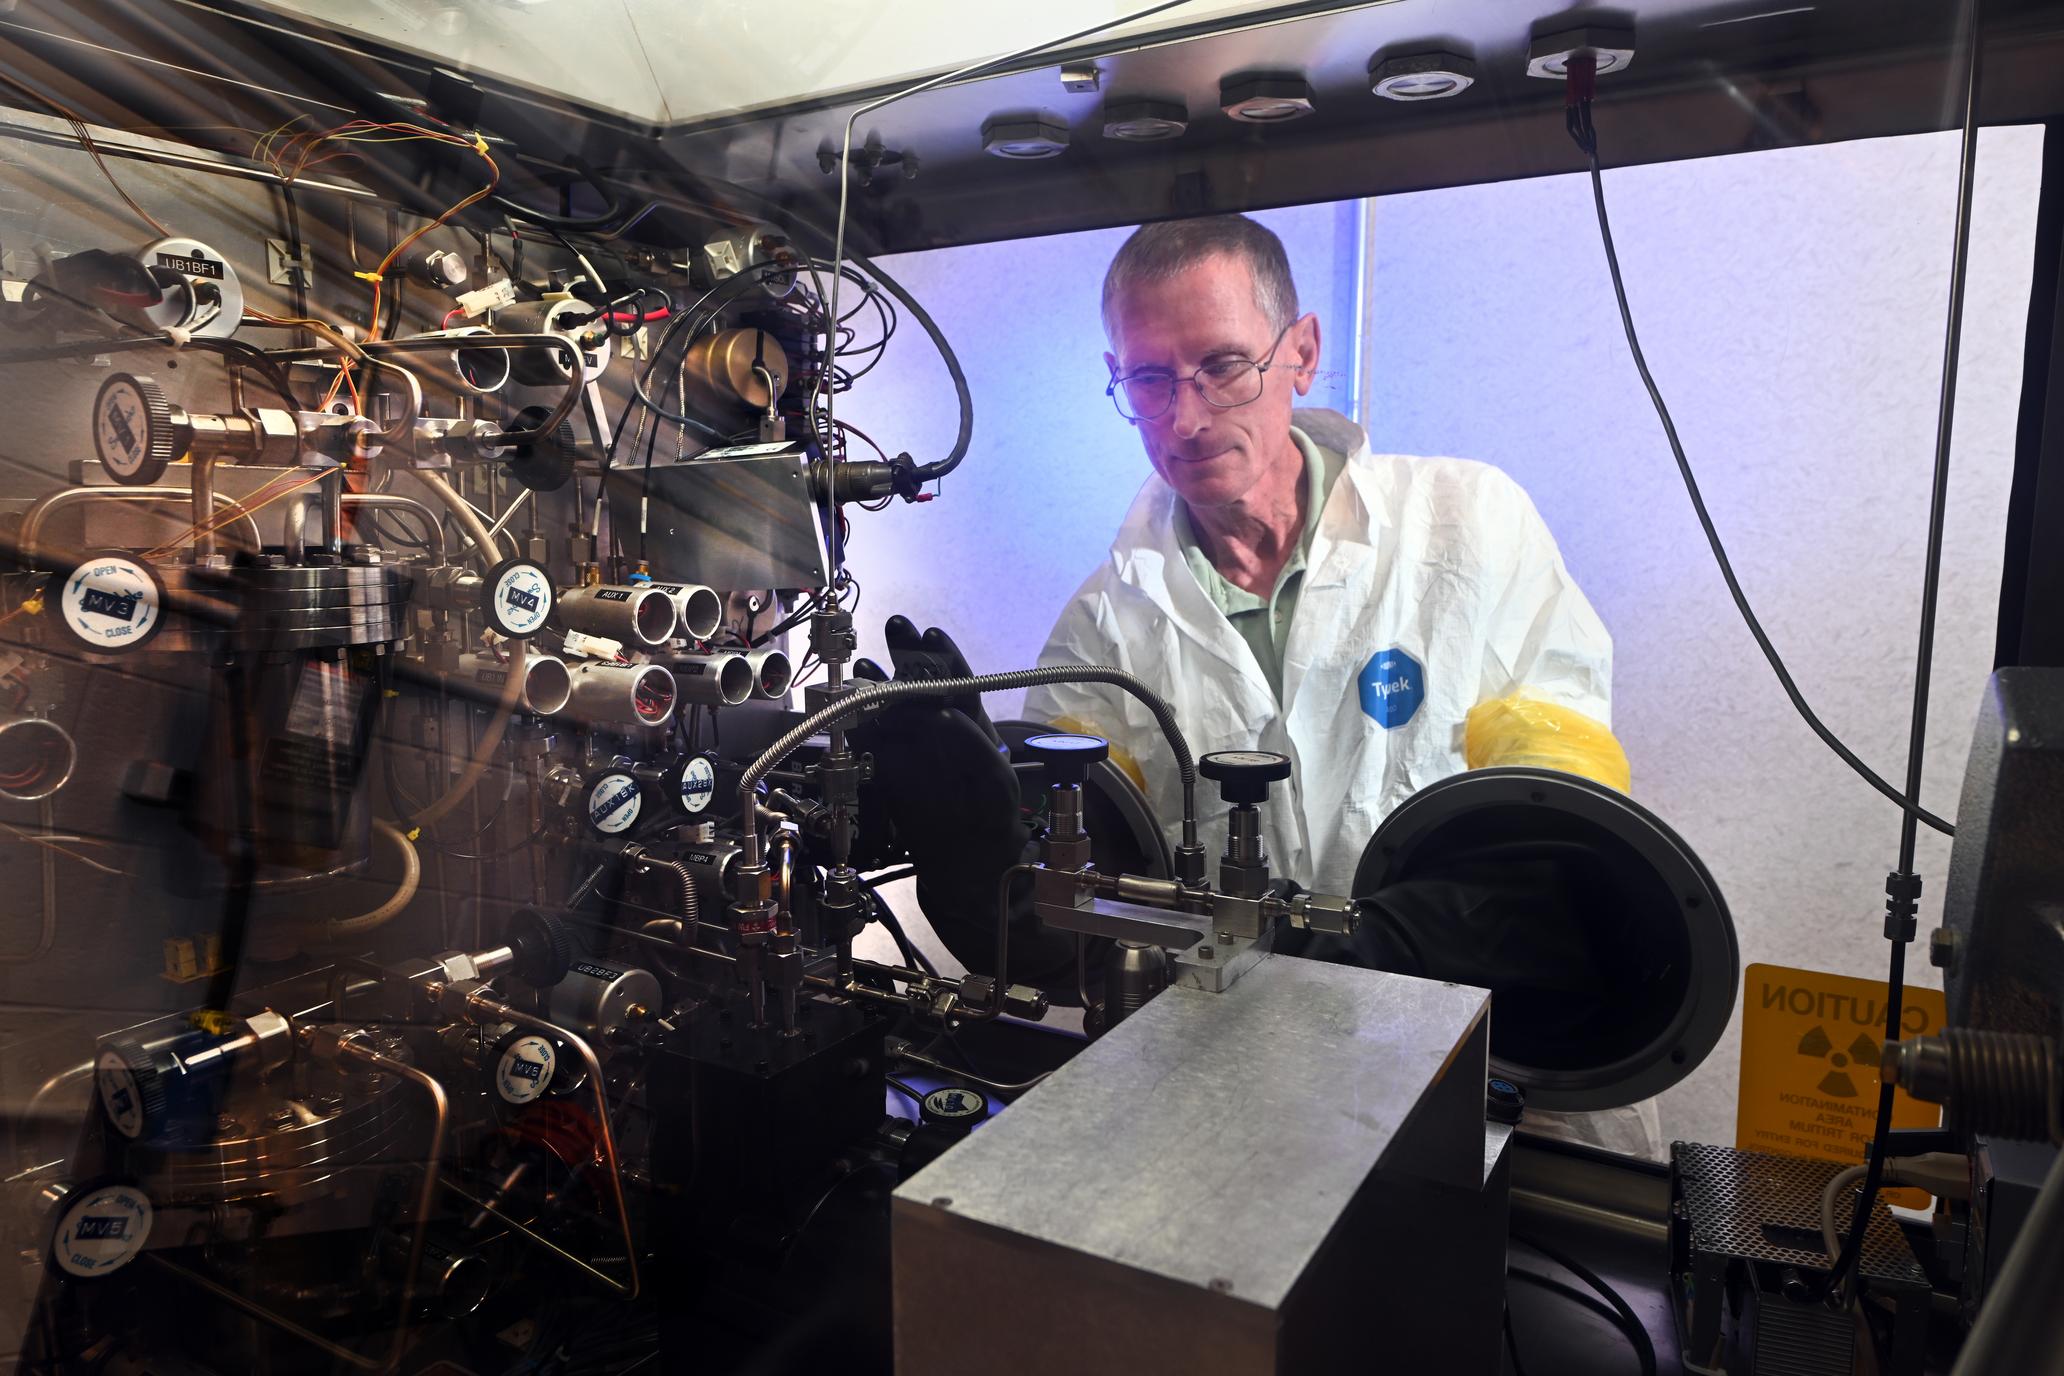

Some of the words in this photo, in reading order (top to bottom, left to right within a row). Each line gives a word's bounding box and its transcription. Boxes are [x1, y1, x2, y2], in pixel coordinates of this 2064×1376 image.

[164, 257, 216, 276] UB1BF1
[93, 565, 117, 577] OPEN
[511, 590, 535, 608] MV4
[601, 591, 619, 599] AUX
[88, 594, 130, 615] MV3
[105, 625, 133, 638] CLOSE
